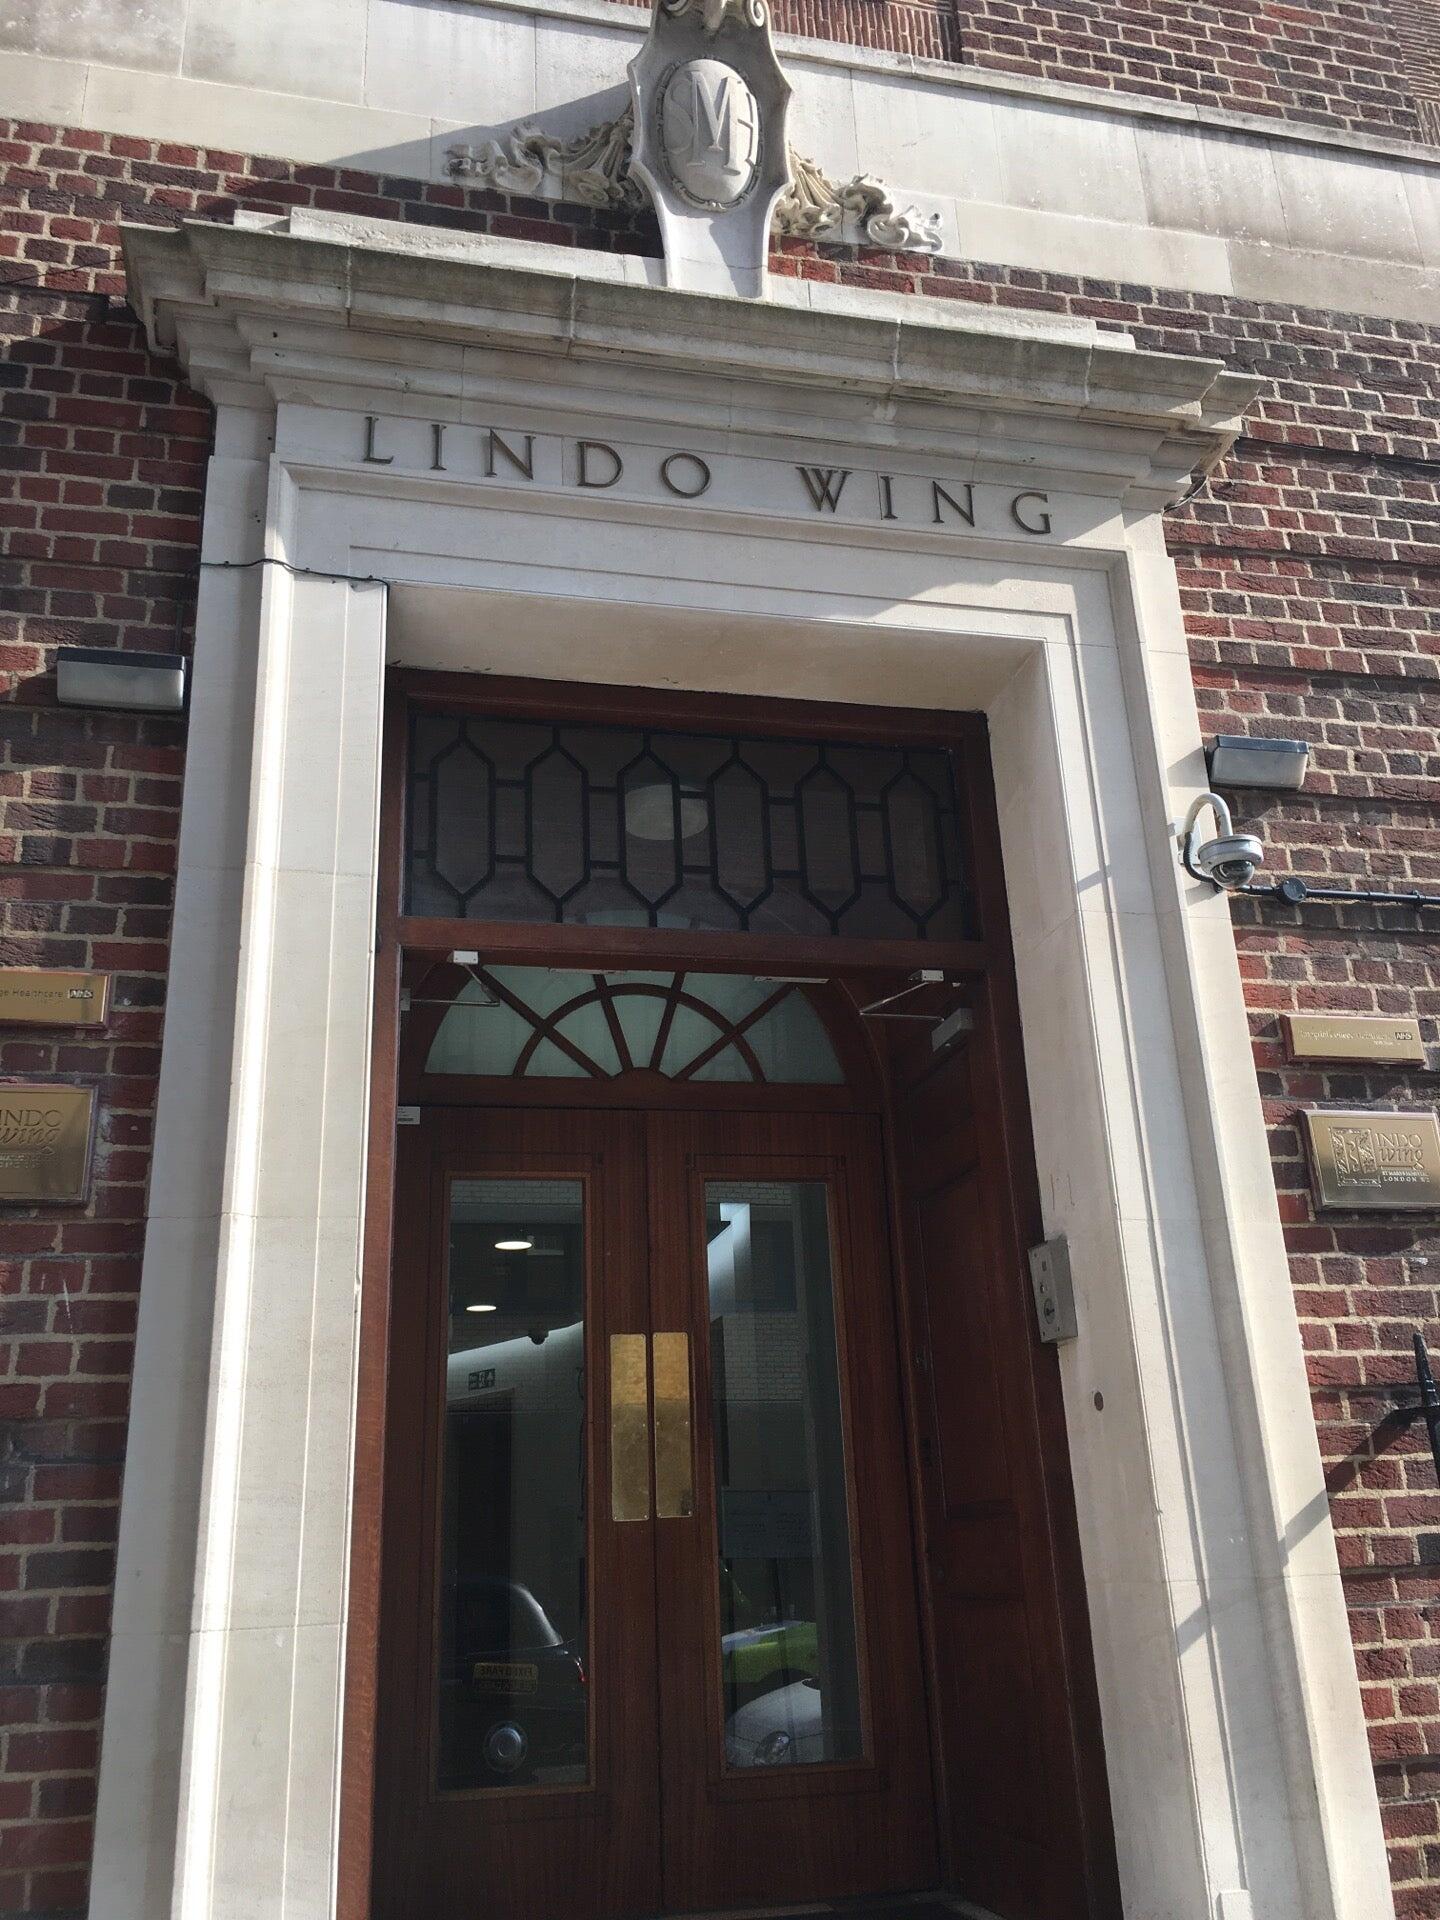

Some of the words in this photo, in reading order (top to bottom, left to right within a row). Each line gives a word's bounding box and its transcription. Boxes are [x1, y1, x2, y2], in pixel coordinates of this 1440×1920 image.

[363, 415, 711, 498] LINDO
[795, 466, 1052, 534] WING
[1395, 1032, 1412, 1040] NHS
